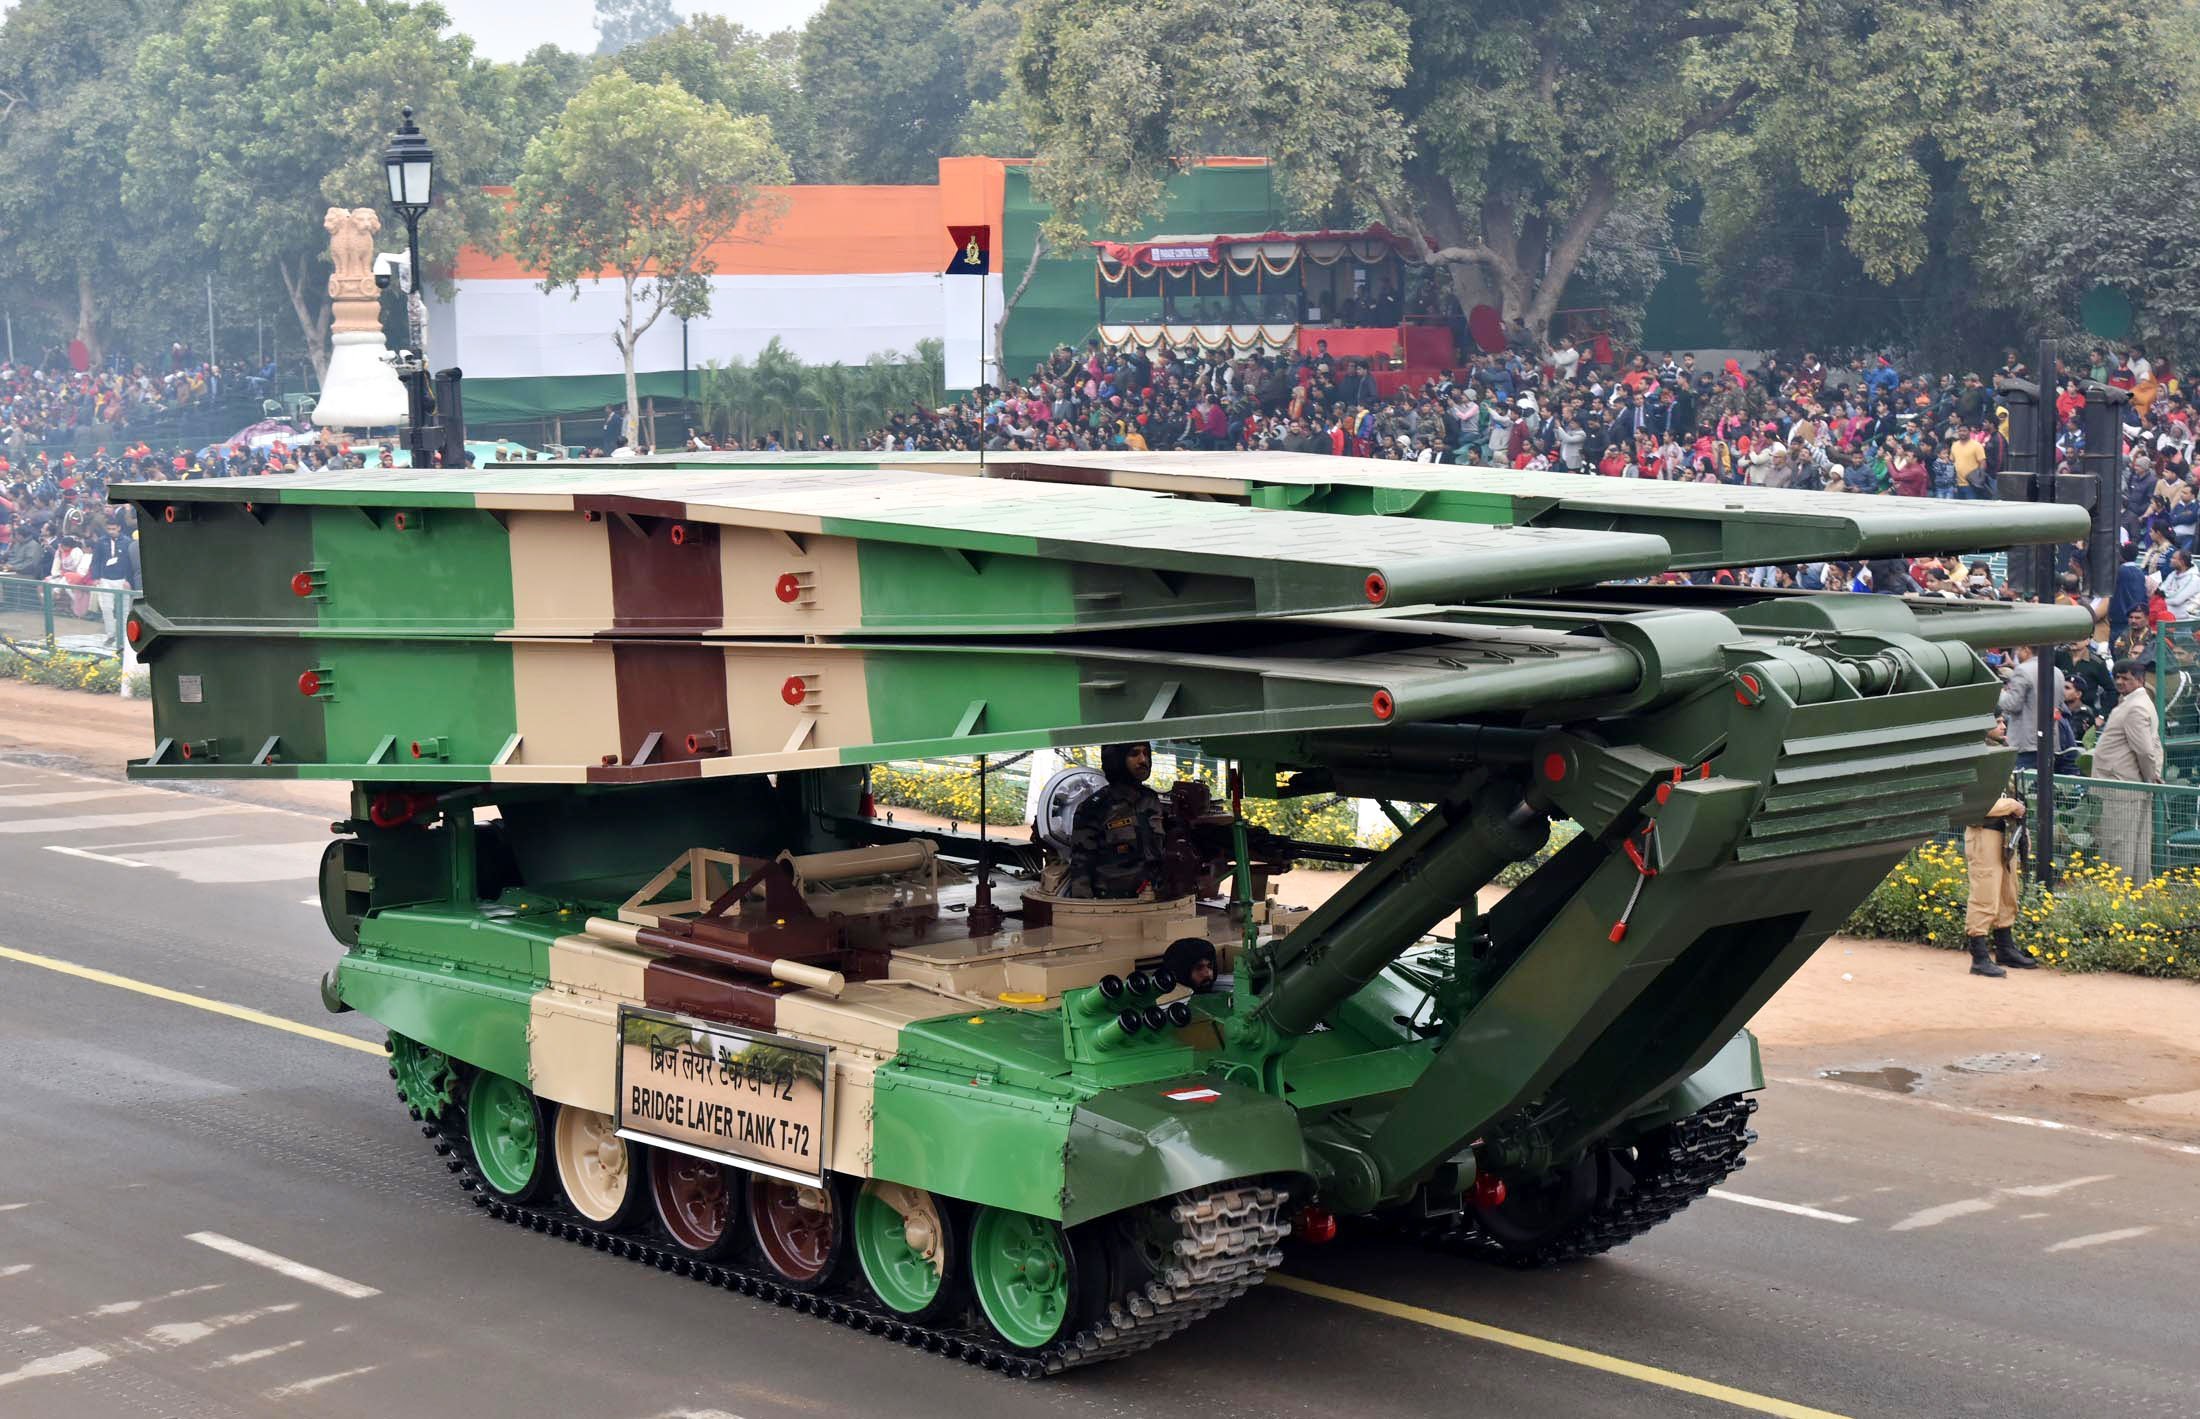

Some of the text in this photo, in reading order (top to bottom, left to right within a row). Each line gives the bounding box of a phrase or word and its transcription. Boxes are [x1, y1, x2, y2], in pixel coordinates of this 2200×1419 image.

[650, 1033, 679, 1076] ब्रिज
[682, 1039, 715, 1086] लेयर
[718, 1045, 743, 1090] टैंक
[632, 1085, 809, 1156] BRIDGE LAYER TANK T-72
